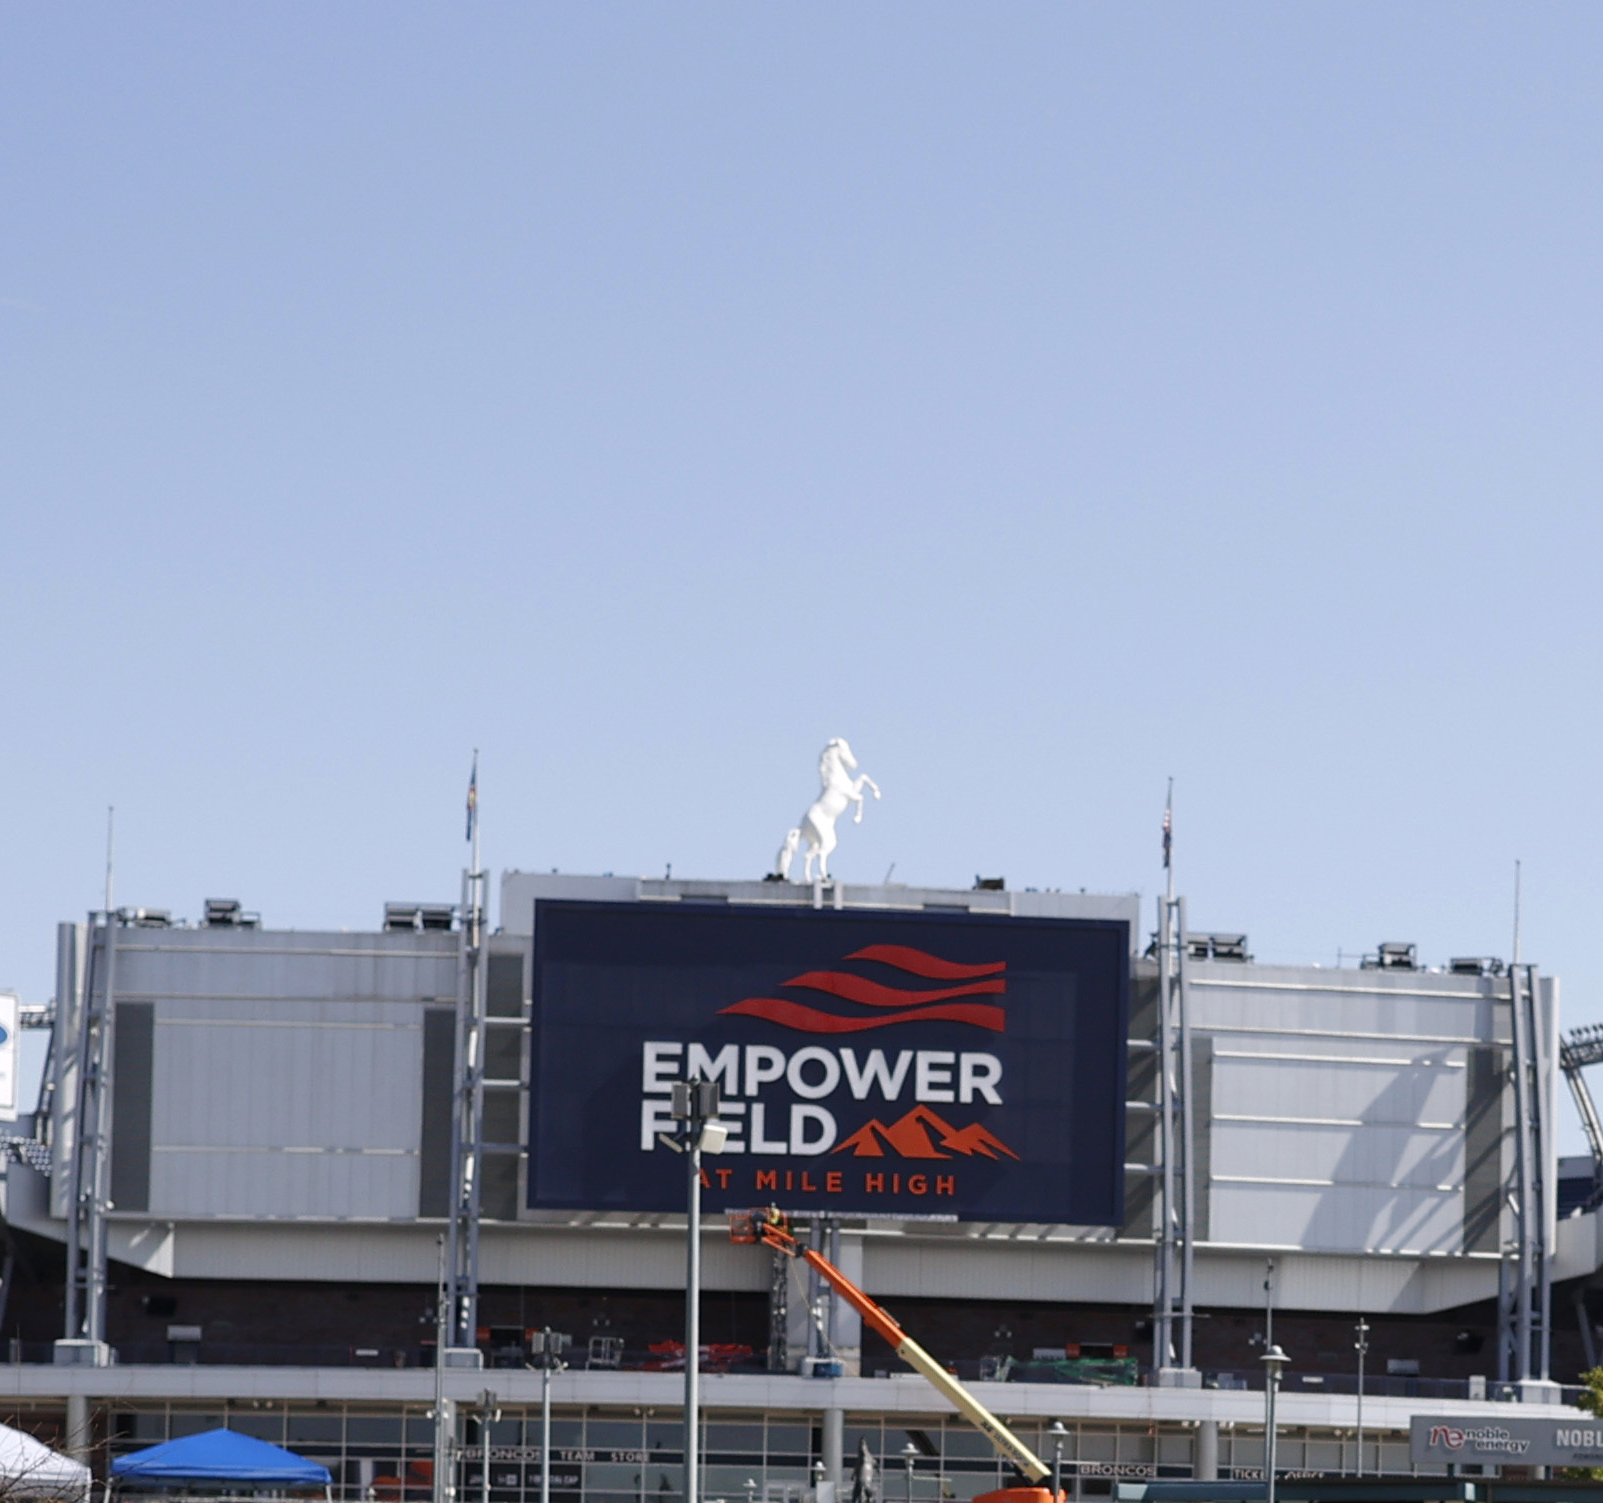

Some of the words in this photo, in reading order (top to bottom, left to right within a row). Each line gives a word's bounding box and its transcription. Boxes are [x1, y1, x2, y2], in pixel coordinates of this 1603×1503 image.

[642, 1041, 1004, 1105] EMPOWER
[755, 1169, 844, 1192] MILE
[865, 1172, 956, 1196] HIGH
[1464, 1426, 1511, 1441] noble
[1475, 1438, 1531, 1455] energy
[559, 1450, 596, 1461] TEAM
[1080, 1464, 1157, 1477] BRONCOS
